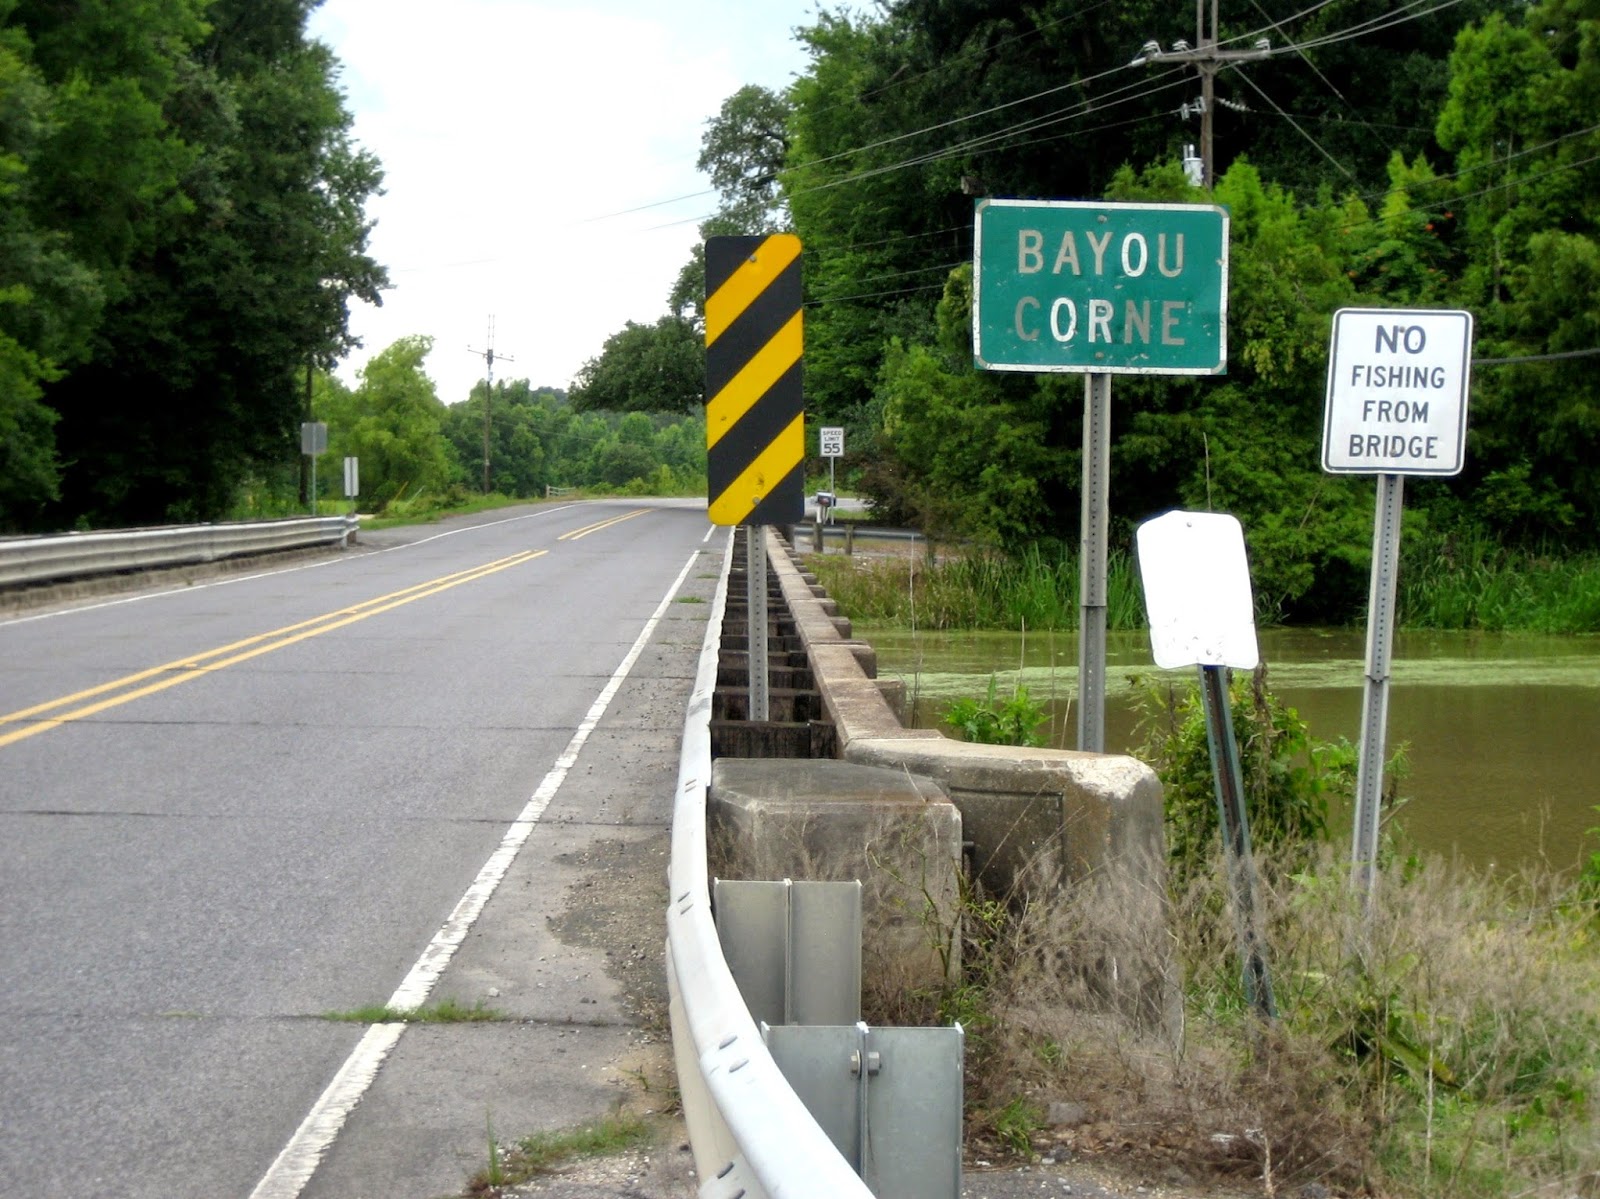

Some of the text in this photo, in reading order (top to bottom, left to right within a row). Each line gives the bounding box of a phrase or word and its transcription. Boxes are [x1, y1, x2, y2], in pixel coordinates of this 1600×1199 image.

[1017, 229, 1185, 278] BAYOU
[1015, 296, 1186, 346] CORNE
[1375, 325, 1427, 355] NO
[1351, 365, 1446, 390] FISHING
[1362, 400, 1429, 424] FROM
[824, 443, 840, 454] 55
[1348, 434, 1439, 460] BRIDGE
